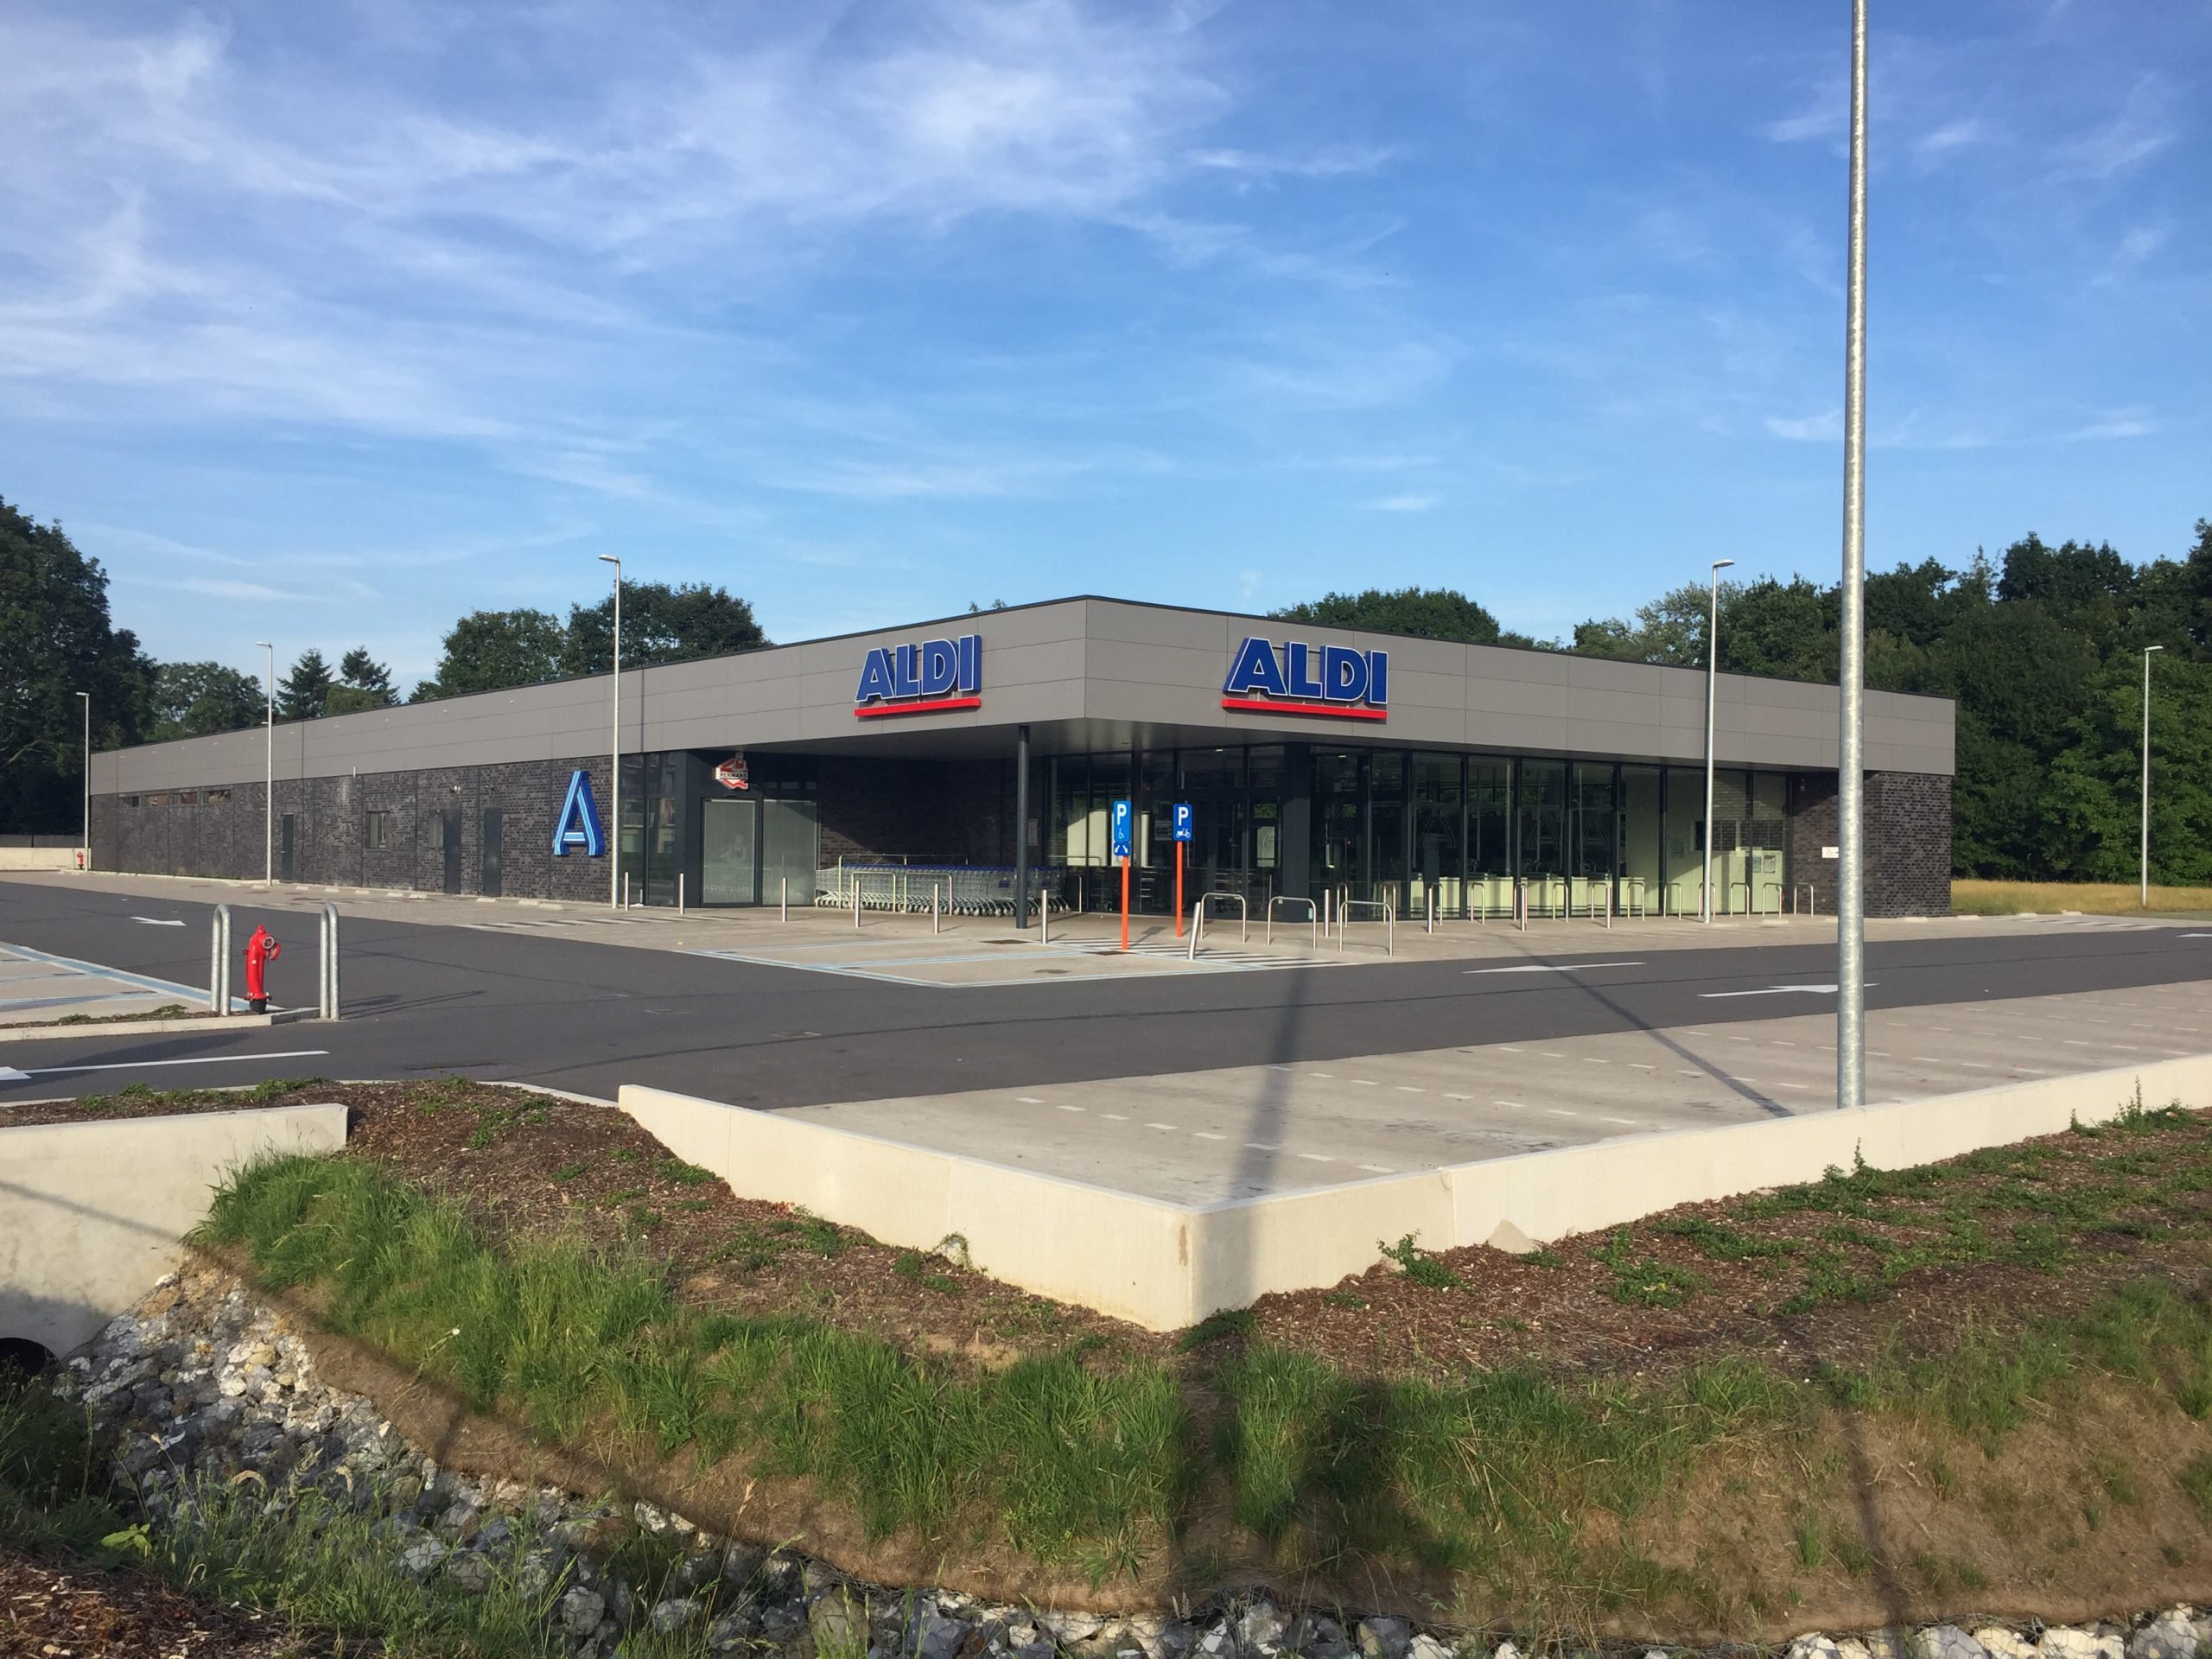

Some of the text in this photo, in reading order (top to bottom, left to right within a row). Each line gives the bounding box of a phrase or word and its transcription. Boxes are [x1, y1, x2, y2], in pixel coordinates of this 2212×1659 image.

[855, 635, 982, 702] ALDI
[1223, 637, 1389, 704] ALDI
[553, 770, 606, 858] A
[1117, 804, 1127, 825] P
[1178, 806, 1189, 826] P
